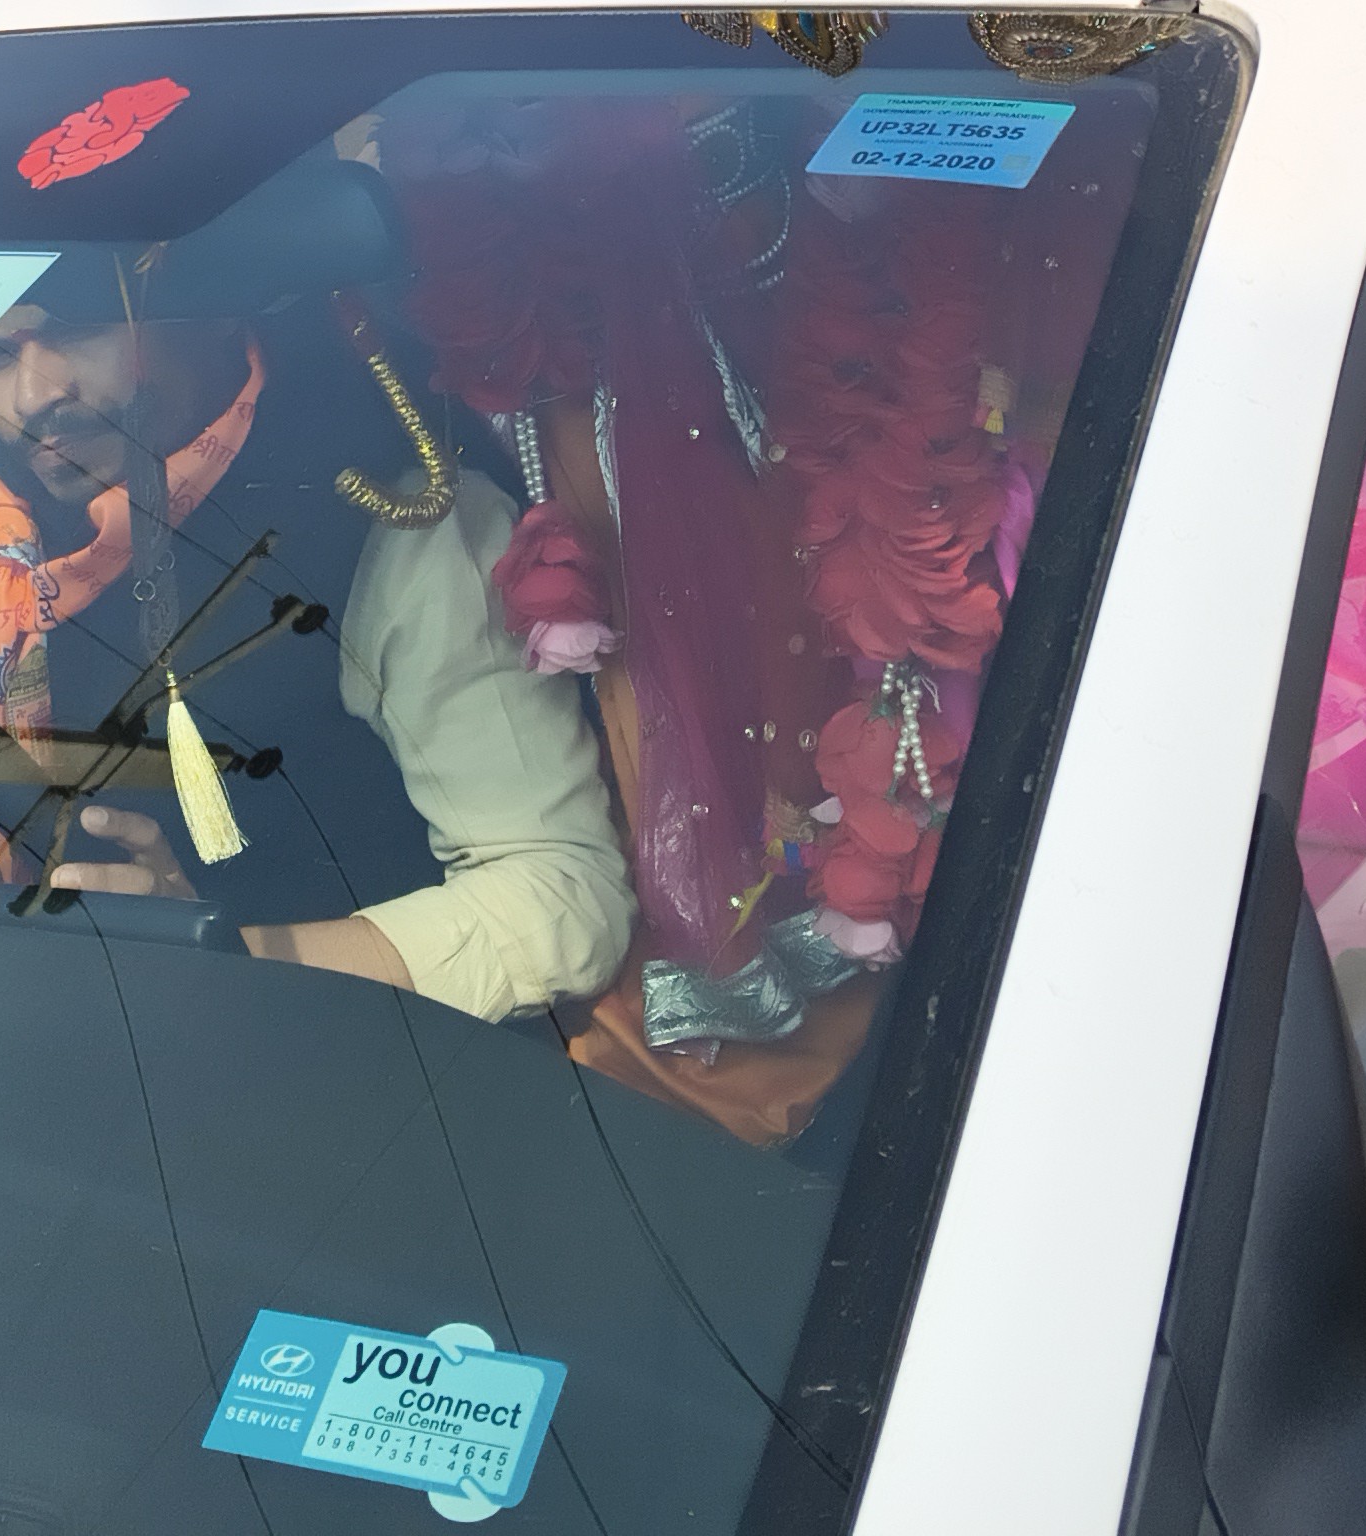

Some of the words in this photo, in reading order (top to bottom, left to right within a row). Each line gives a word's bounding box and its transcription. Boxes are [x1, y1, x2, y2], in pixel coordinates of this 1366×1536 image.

[859, 121, 1026, 141] UP32LT5635
[850, 151, 996, 170] 02-12-2020
[342, 1341, 441, 1387] you
[238, 1374, 315, 1400] HYUNDAI
[225, 1407, 302, 1434] SERVICE
[373, 1406, 405, 1425] Call
[408, 1411, 463, 1436] Centre
[398, 1388, 523, 1430] connect
